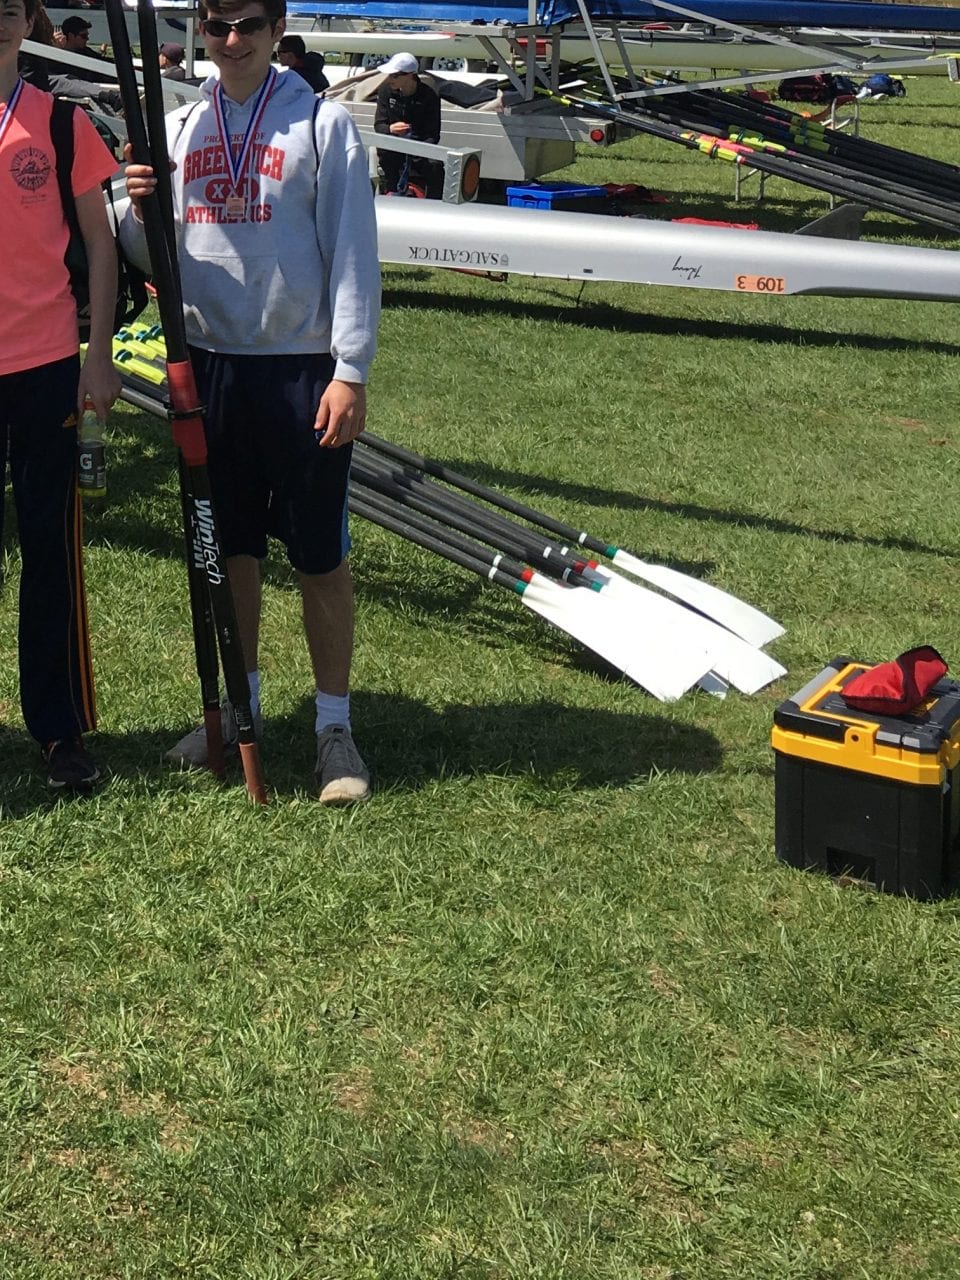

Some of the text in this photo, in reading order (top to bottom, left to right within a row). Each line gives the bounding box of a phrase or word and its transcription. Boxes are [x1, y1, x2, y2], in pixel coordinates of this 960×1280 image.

[408, 246, 500, 266] SAUGATUCK
[737, 275, 784, 293] 109 3
[80, 453, 93, 470] G
[194, 499, 225, 585] WinTech
